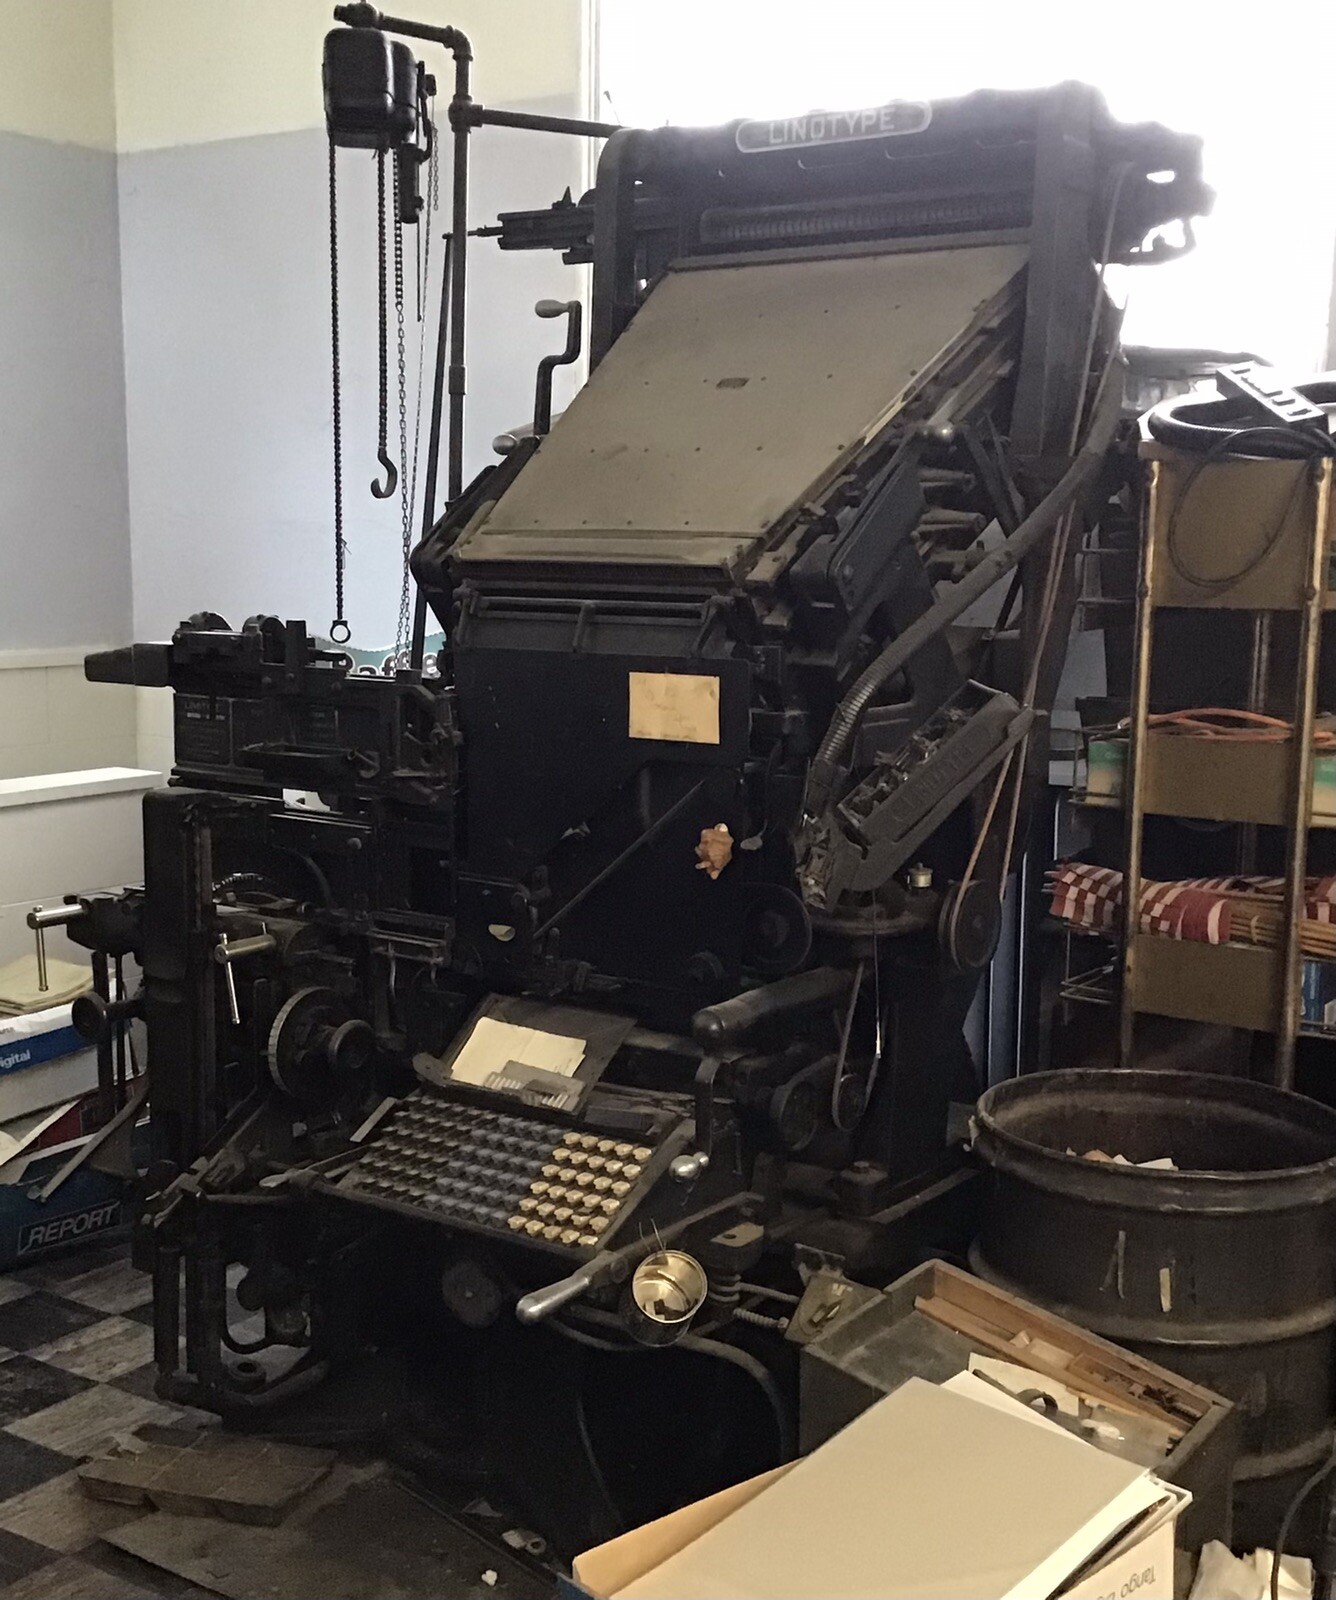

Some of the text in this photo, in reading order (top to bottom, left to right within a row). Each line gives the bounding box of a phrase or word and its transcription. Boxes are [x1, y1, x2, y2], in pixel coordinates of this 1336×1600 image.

[768, 106, 896, 145] LINOTYPE
[0, 1049, 31, 1069] igital
[27, 1203, 118, 1246] REPORT
[1120, 1565, 1156, 1598] Tango
